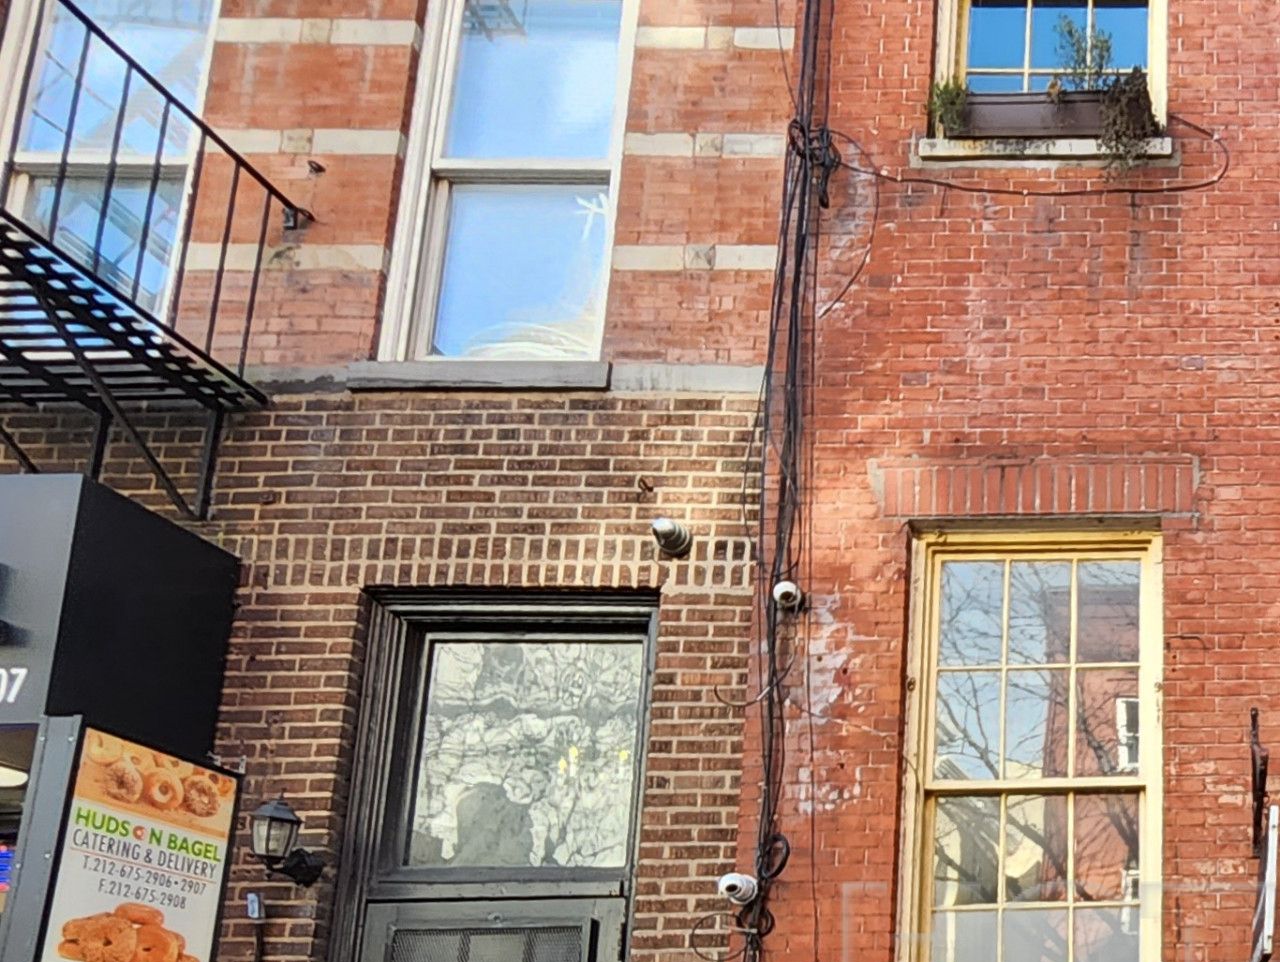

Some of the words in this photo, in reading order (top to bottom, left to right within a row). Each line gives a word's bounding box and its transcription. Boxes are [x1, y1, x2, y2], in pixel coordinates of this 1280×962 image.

[73, 828, 141, 861] CATERING
[144, 849, 153, 864] &
[158, 850, 217, 879] DELIVERY
[167, 833, 221, 863] BAGEL
